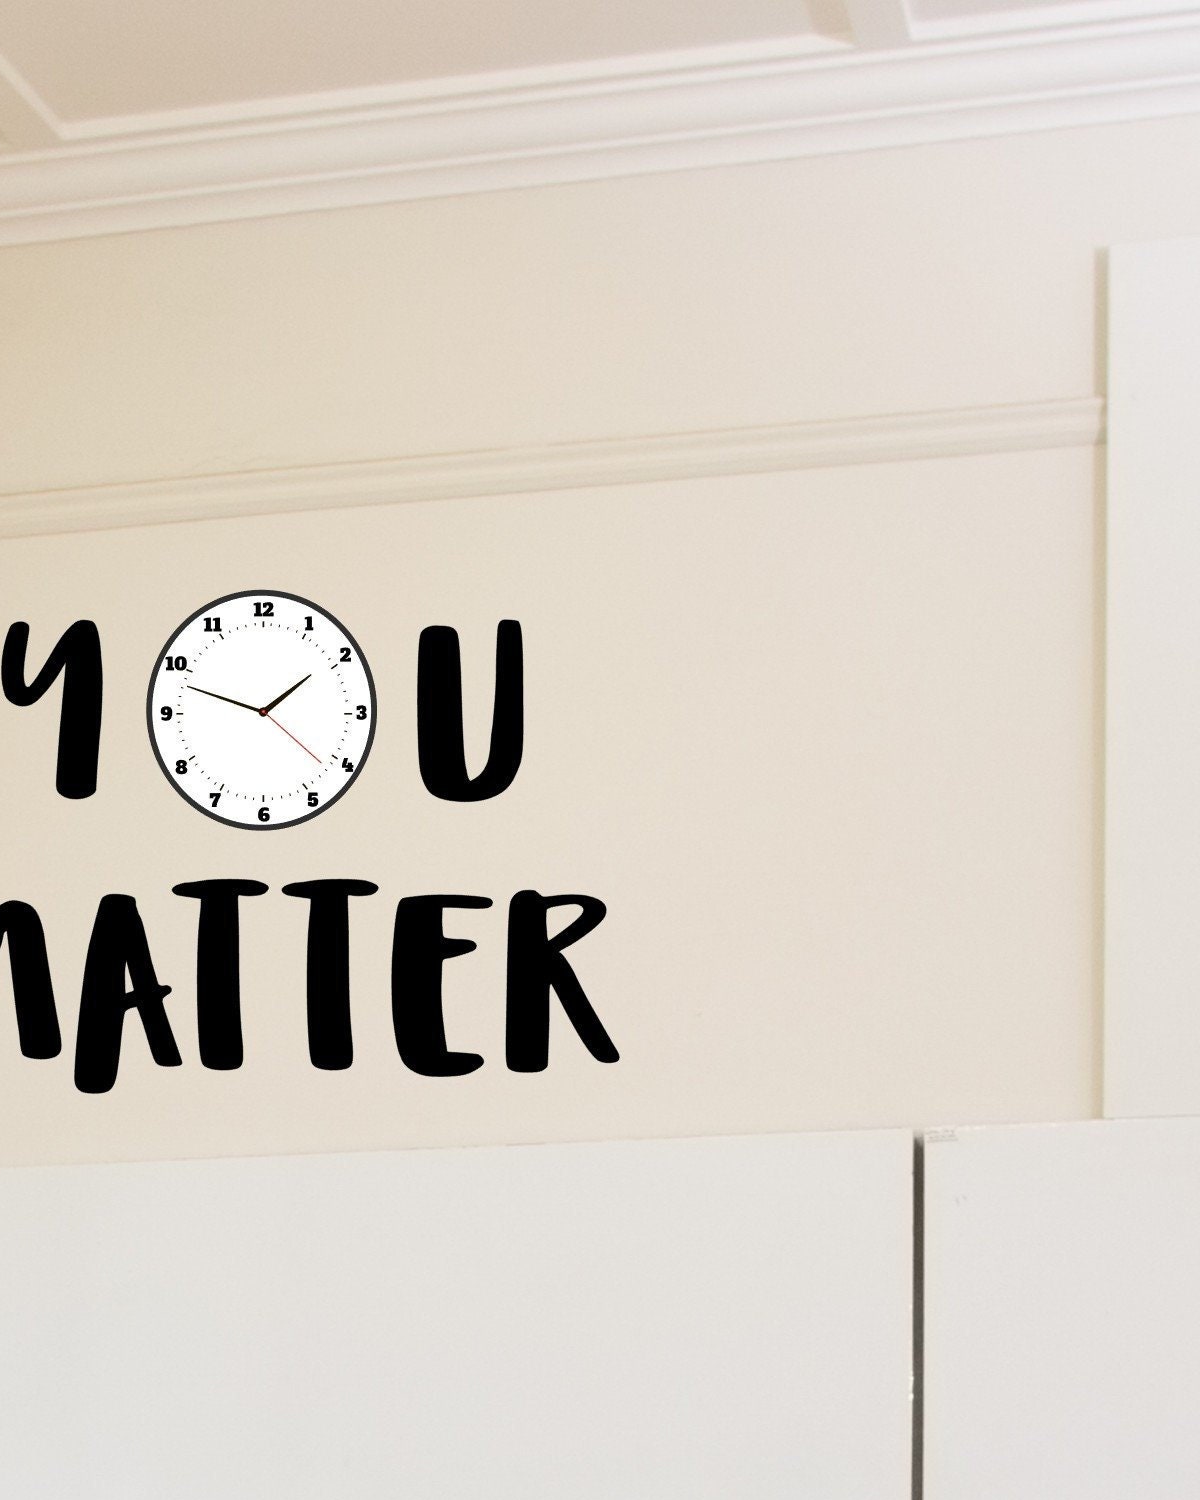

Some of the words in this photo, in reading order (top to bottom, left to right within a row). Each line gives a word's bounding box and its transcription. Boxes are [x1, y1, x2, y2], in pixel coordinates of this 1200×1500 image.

[253, 601, 275, 617] 12
[203, 617, 222, 632] 11
[304, 616, 314, 631] 1
[339, 647, 352, 662] 2
[165, 656, 188, 671] 10
[160, 705, 173, 721] 9
[356, 704, 368, 720] 3
[175, 759, 188, 774] 8
[341, 757, 354, 773] 4
[209, 792, 221, 808] 7
[307, 792, 319, 808] 5
[257, 806, 271, 822] 6
